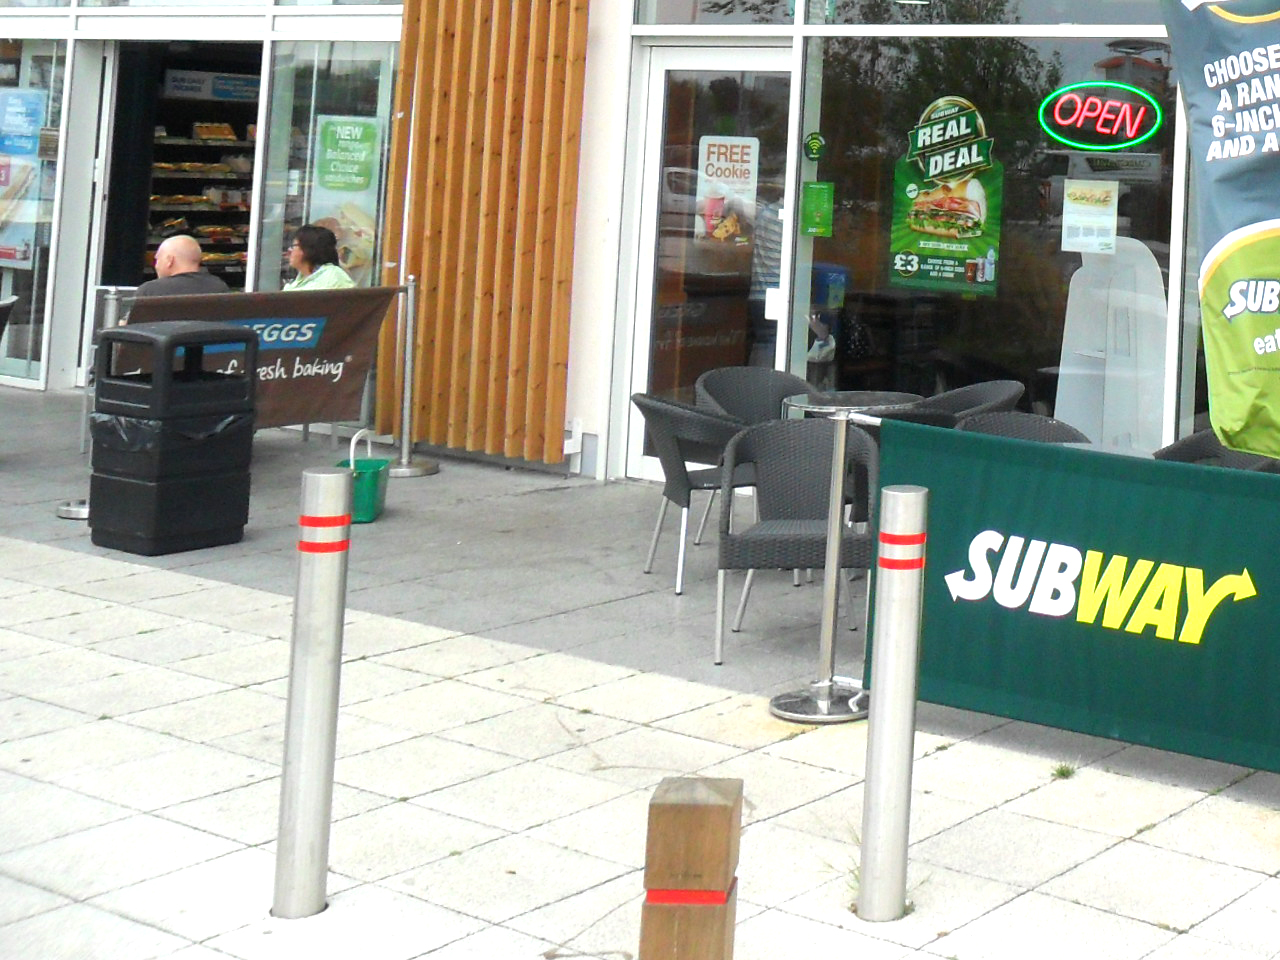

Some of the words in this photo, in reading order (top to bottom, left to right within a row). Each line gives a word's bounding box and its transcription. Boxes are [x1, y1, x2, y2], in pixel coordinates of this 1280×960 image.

[1216, 88, 1233, 112] A
[930, 106, 960, 120] SUBWAY
[1053, 92, 1148, 139] OPEN
[336, 125, 364, 140] NEW
[917, 116, 971, 148] REAL
[706, 143, 752, 164] FREE
[1205, 134, 1256, 162] AND
[1261, 132, 1280, 153] A
[705, 163, 751, 179] Cookie
[928, 143, 983, 177] DEAL
[894, 254, 919, 272] £3
[944, 530, 1257, 645] SUBWAY
